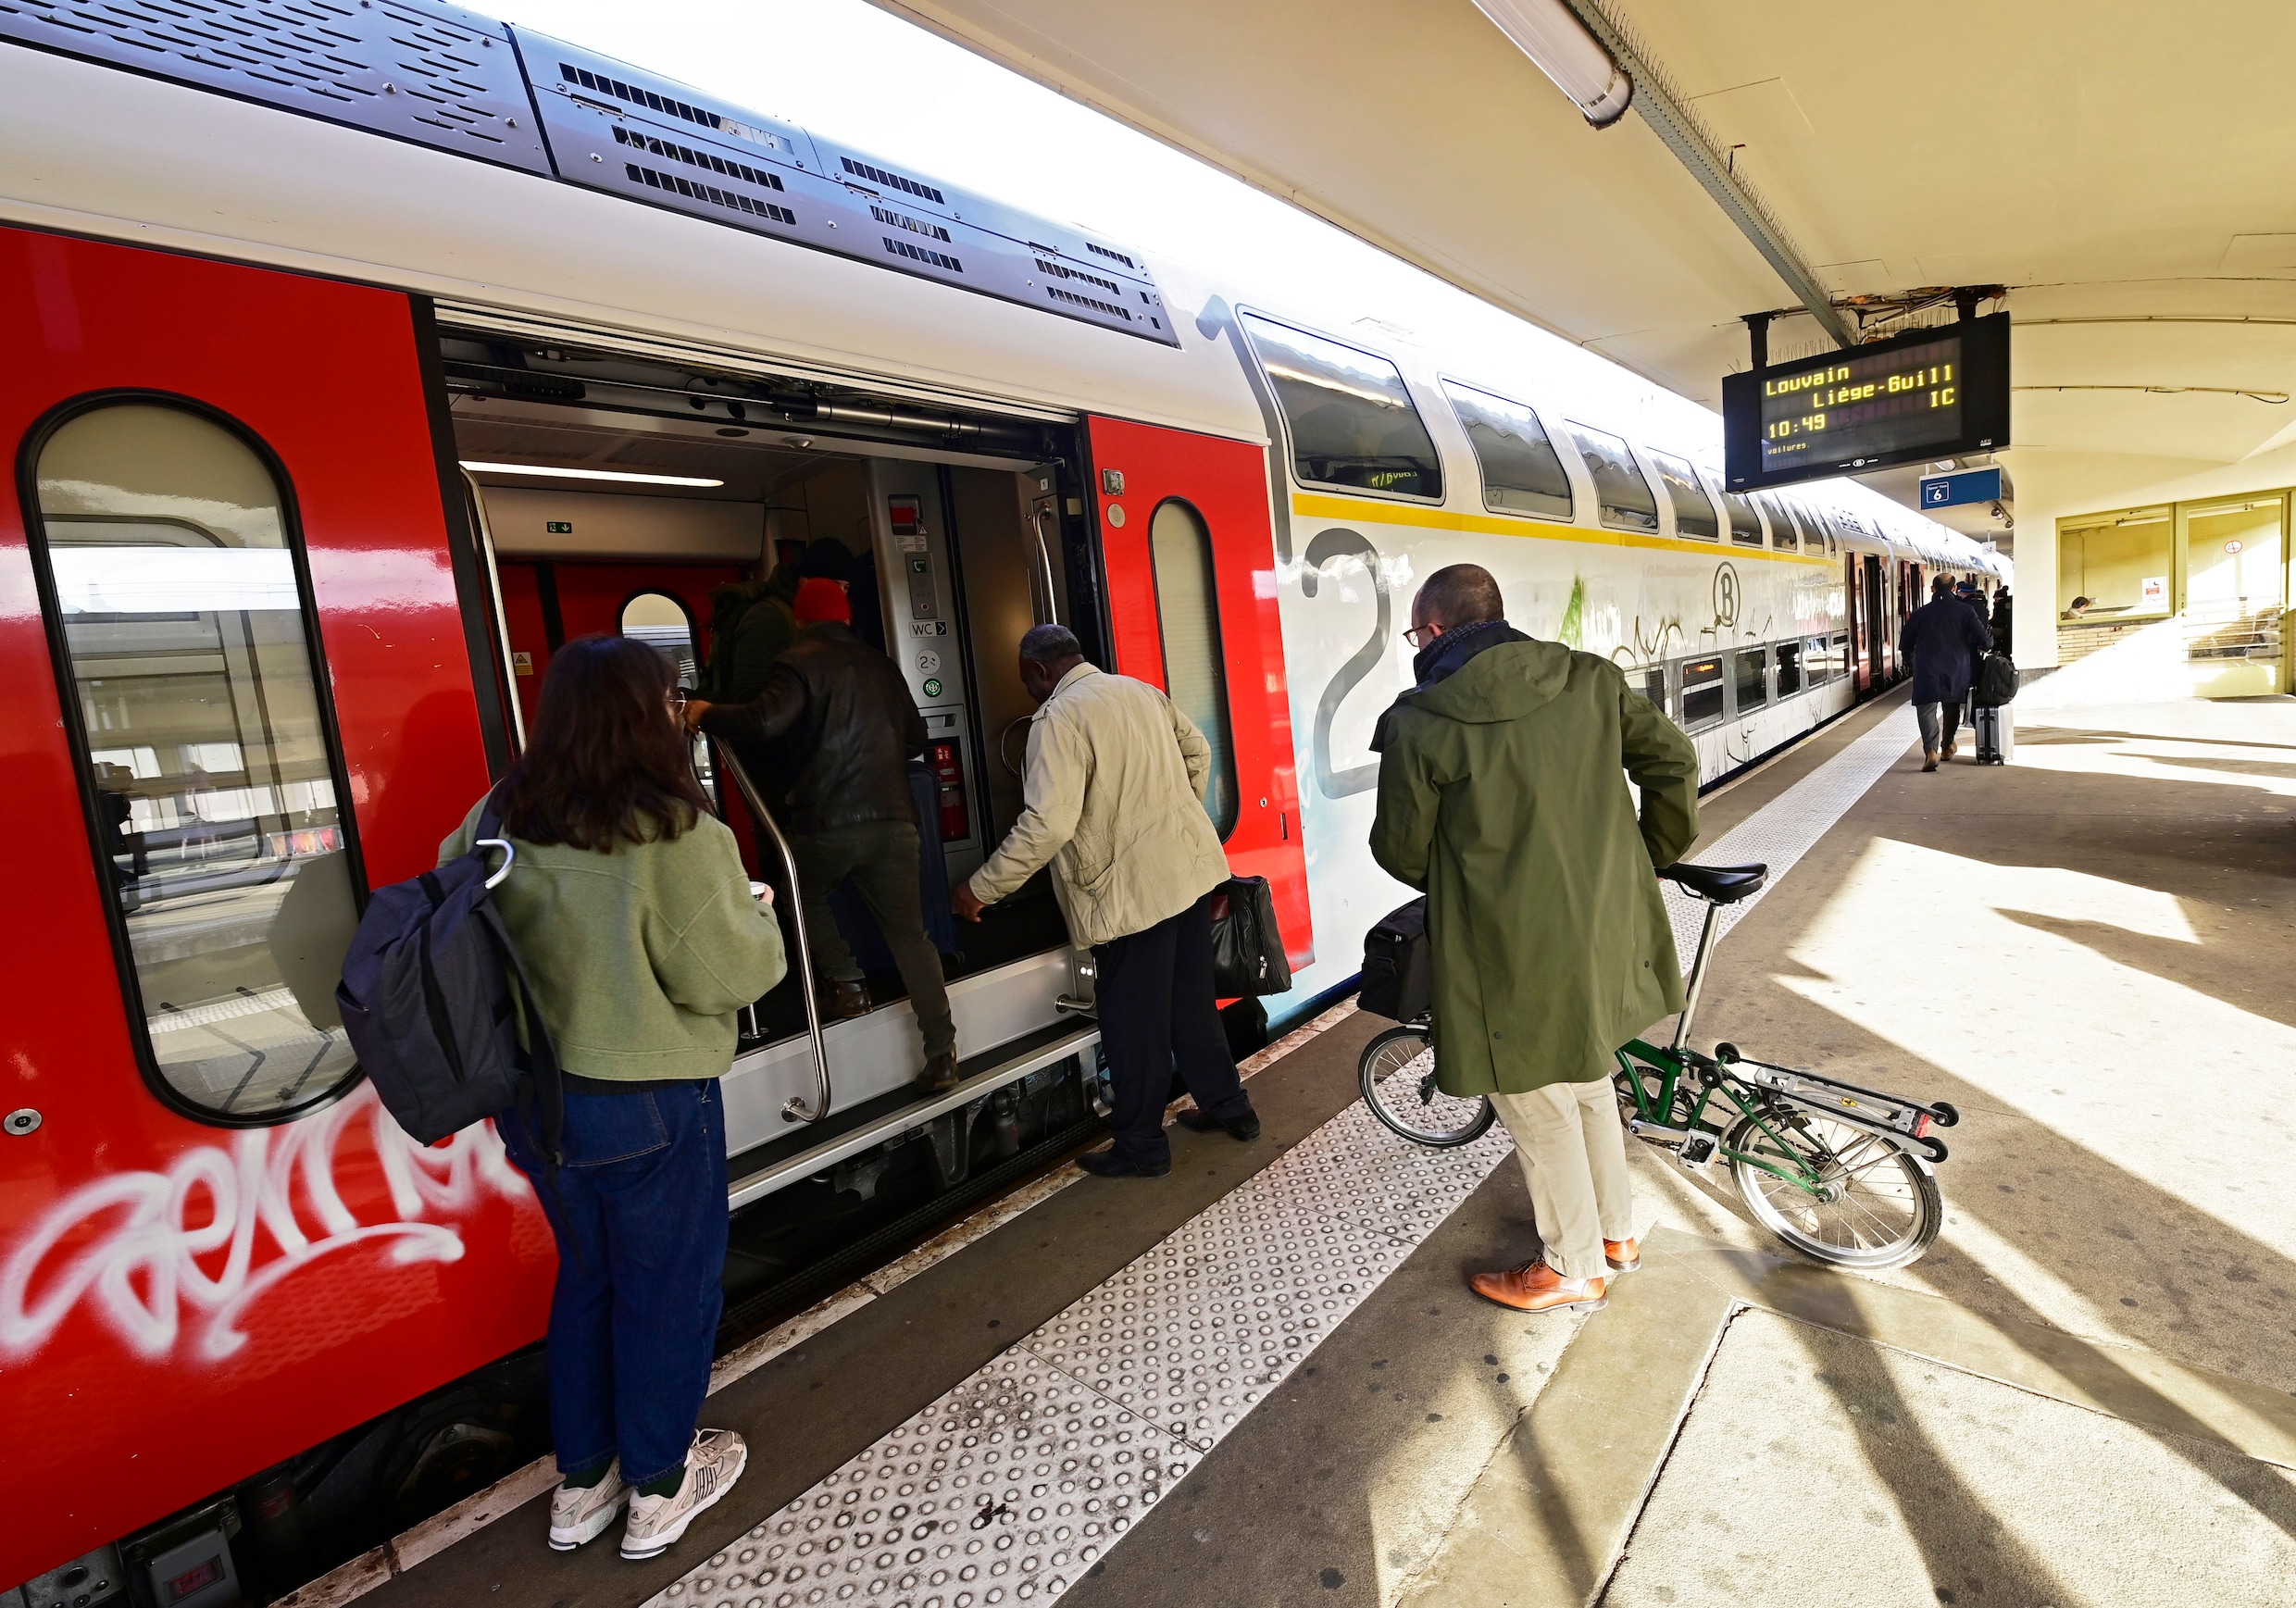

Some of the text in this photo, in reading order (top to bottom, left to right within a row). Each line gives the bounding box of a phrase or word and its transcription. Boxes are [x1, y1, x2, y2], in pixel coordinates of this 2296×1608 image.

[1766, 367, 1850, 396] Louvain
[1814, 365, 1953, 408] Liège-Guill
[1930, 388, 1954, 407] IC
[1769, 414, 1826, 439] 10:49
[1933, 489, 1942, 501] 6
[912, 623, 933, 636] WC
[919, 655, 929, 668] 2
[1302, 528, 1391, 800] 2
